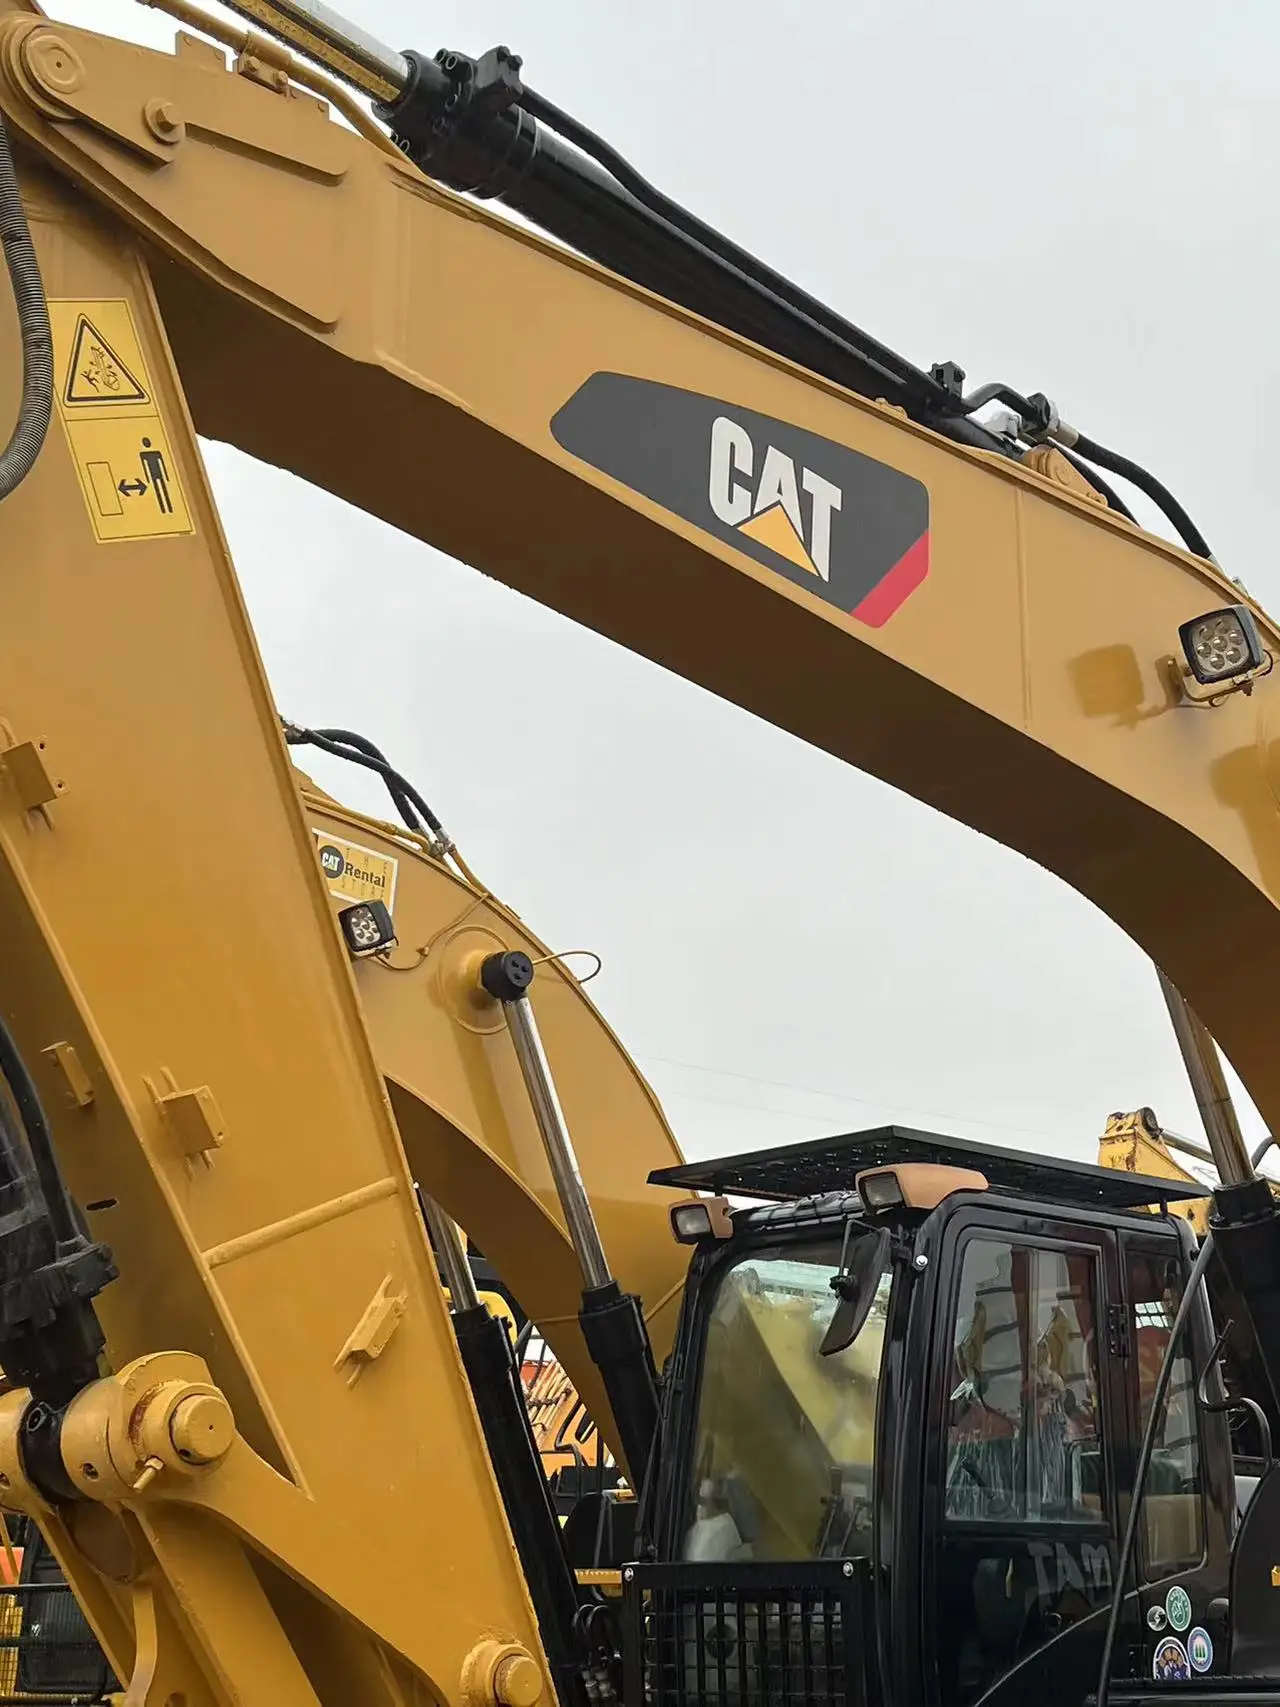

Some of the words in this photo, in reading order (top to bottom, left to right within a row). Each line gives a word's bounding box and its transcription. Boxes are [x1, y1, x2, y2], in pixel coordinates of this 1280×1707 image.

[709, 416, 842, 583] CAT
[321, 852, 340, 871] CAT
[344, 862, 386, 888] Rental
